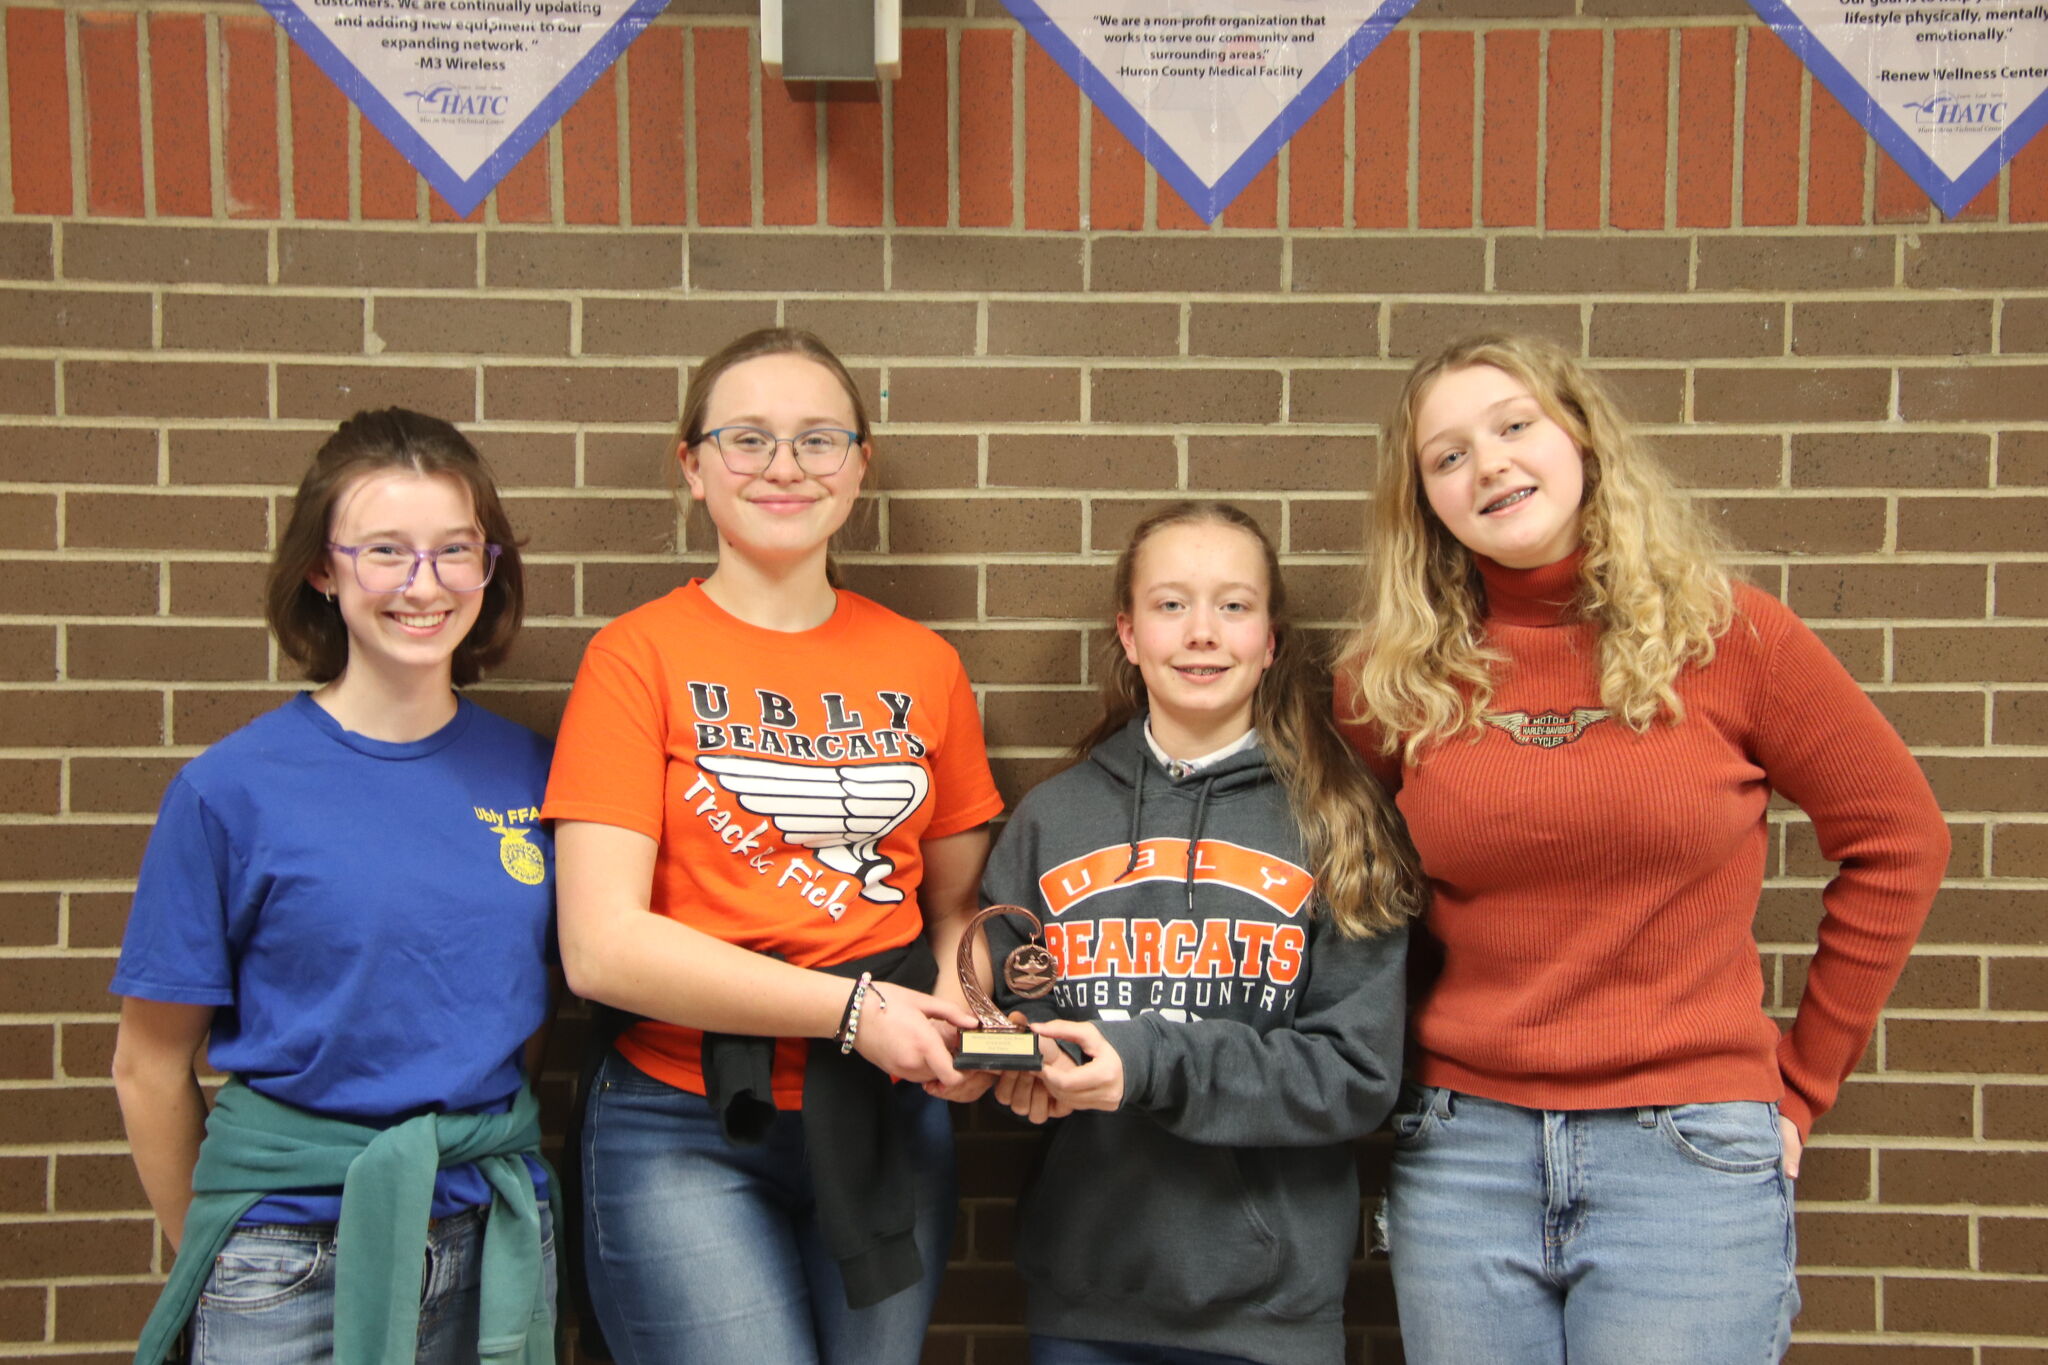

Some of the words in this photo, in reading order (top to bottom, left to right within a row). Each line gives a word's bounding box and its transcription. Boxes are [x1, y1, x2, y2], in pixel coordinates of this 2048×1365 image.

[423, 0, 446, 10] are
[450, 0, 531, 15] continually
[536, 0, 602, 16] updating
[334, 15, 362, 27] and
[366, 16, 418, 31] adding
[422, 20, 451, 30] new
[455, 19, 535, 34] equipment
[540, 21, 554, 32] to
[558, 23, 582, 33] our
[1121, 17, 1141, 26] are
[1143, 17, 1151, 26] a
[1153, 14, 1216, 29] non-profit
[1219, 14, 1298, 28] organization
[1301, 15, 1326, 26] that
[1845, 11, 1902, 27] lifestyle
[1906, 9, 1982, 25] physically,
[381, 37, 460, 52] expanding
[1104, 32, 1140, 43] works
[1143, 32, 1156, 42] to
[1159, 34, 1192, 43] serve
[1195, 34, 1215, 43] our
[1219, 31, 1289, 45] community
[1291, 32, 1315, 42] and
[415, 57, 442, 69] -M3
[446, 58, 506, 70] Wireless
[1150, 49, 1226, 62] surrounding
[1116, 66, 1158, 76] -Huron
[1161, 66, 1205, 79] County
[1209, 66, 1256, 77] Medical
[1260, 66, 1303, 79] Facility
[1875, 69, 1929, 82] -Renew
[1933, 67, 1997, 80] Wellness
[2000, 66, 2048, 78] Center
[441, 95, 509, 116] HATC
[1938, 103, 2007, 124] HATC
[1533, 715, 1565, 725] MOTOR
[1522, 724, 1574, 735] HARLEY-DAVIDSON
[694, 723, 926, 761] BEARCATS
[1532, 736, 1564, 748] CYCLES
[473, 806, 504, 827] Ubly
[507, 806, 541, 825] FFA
[684, 772, 769, 857] Track
[750, 847, 776, 875] &
[777, 858, 851, 922] Field
[1043, 917, 1306, 985] BEARCATS
[1053, 981, 1132, 1007] CROSS
[1150, 980, 1296, 1012] COUNTRY
